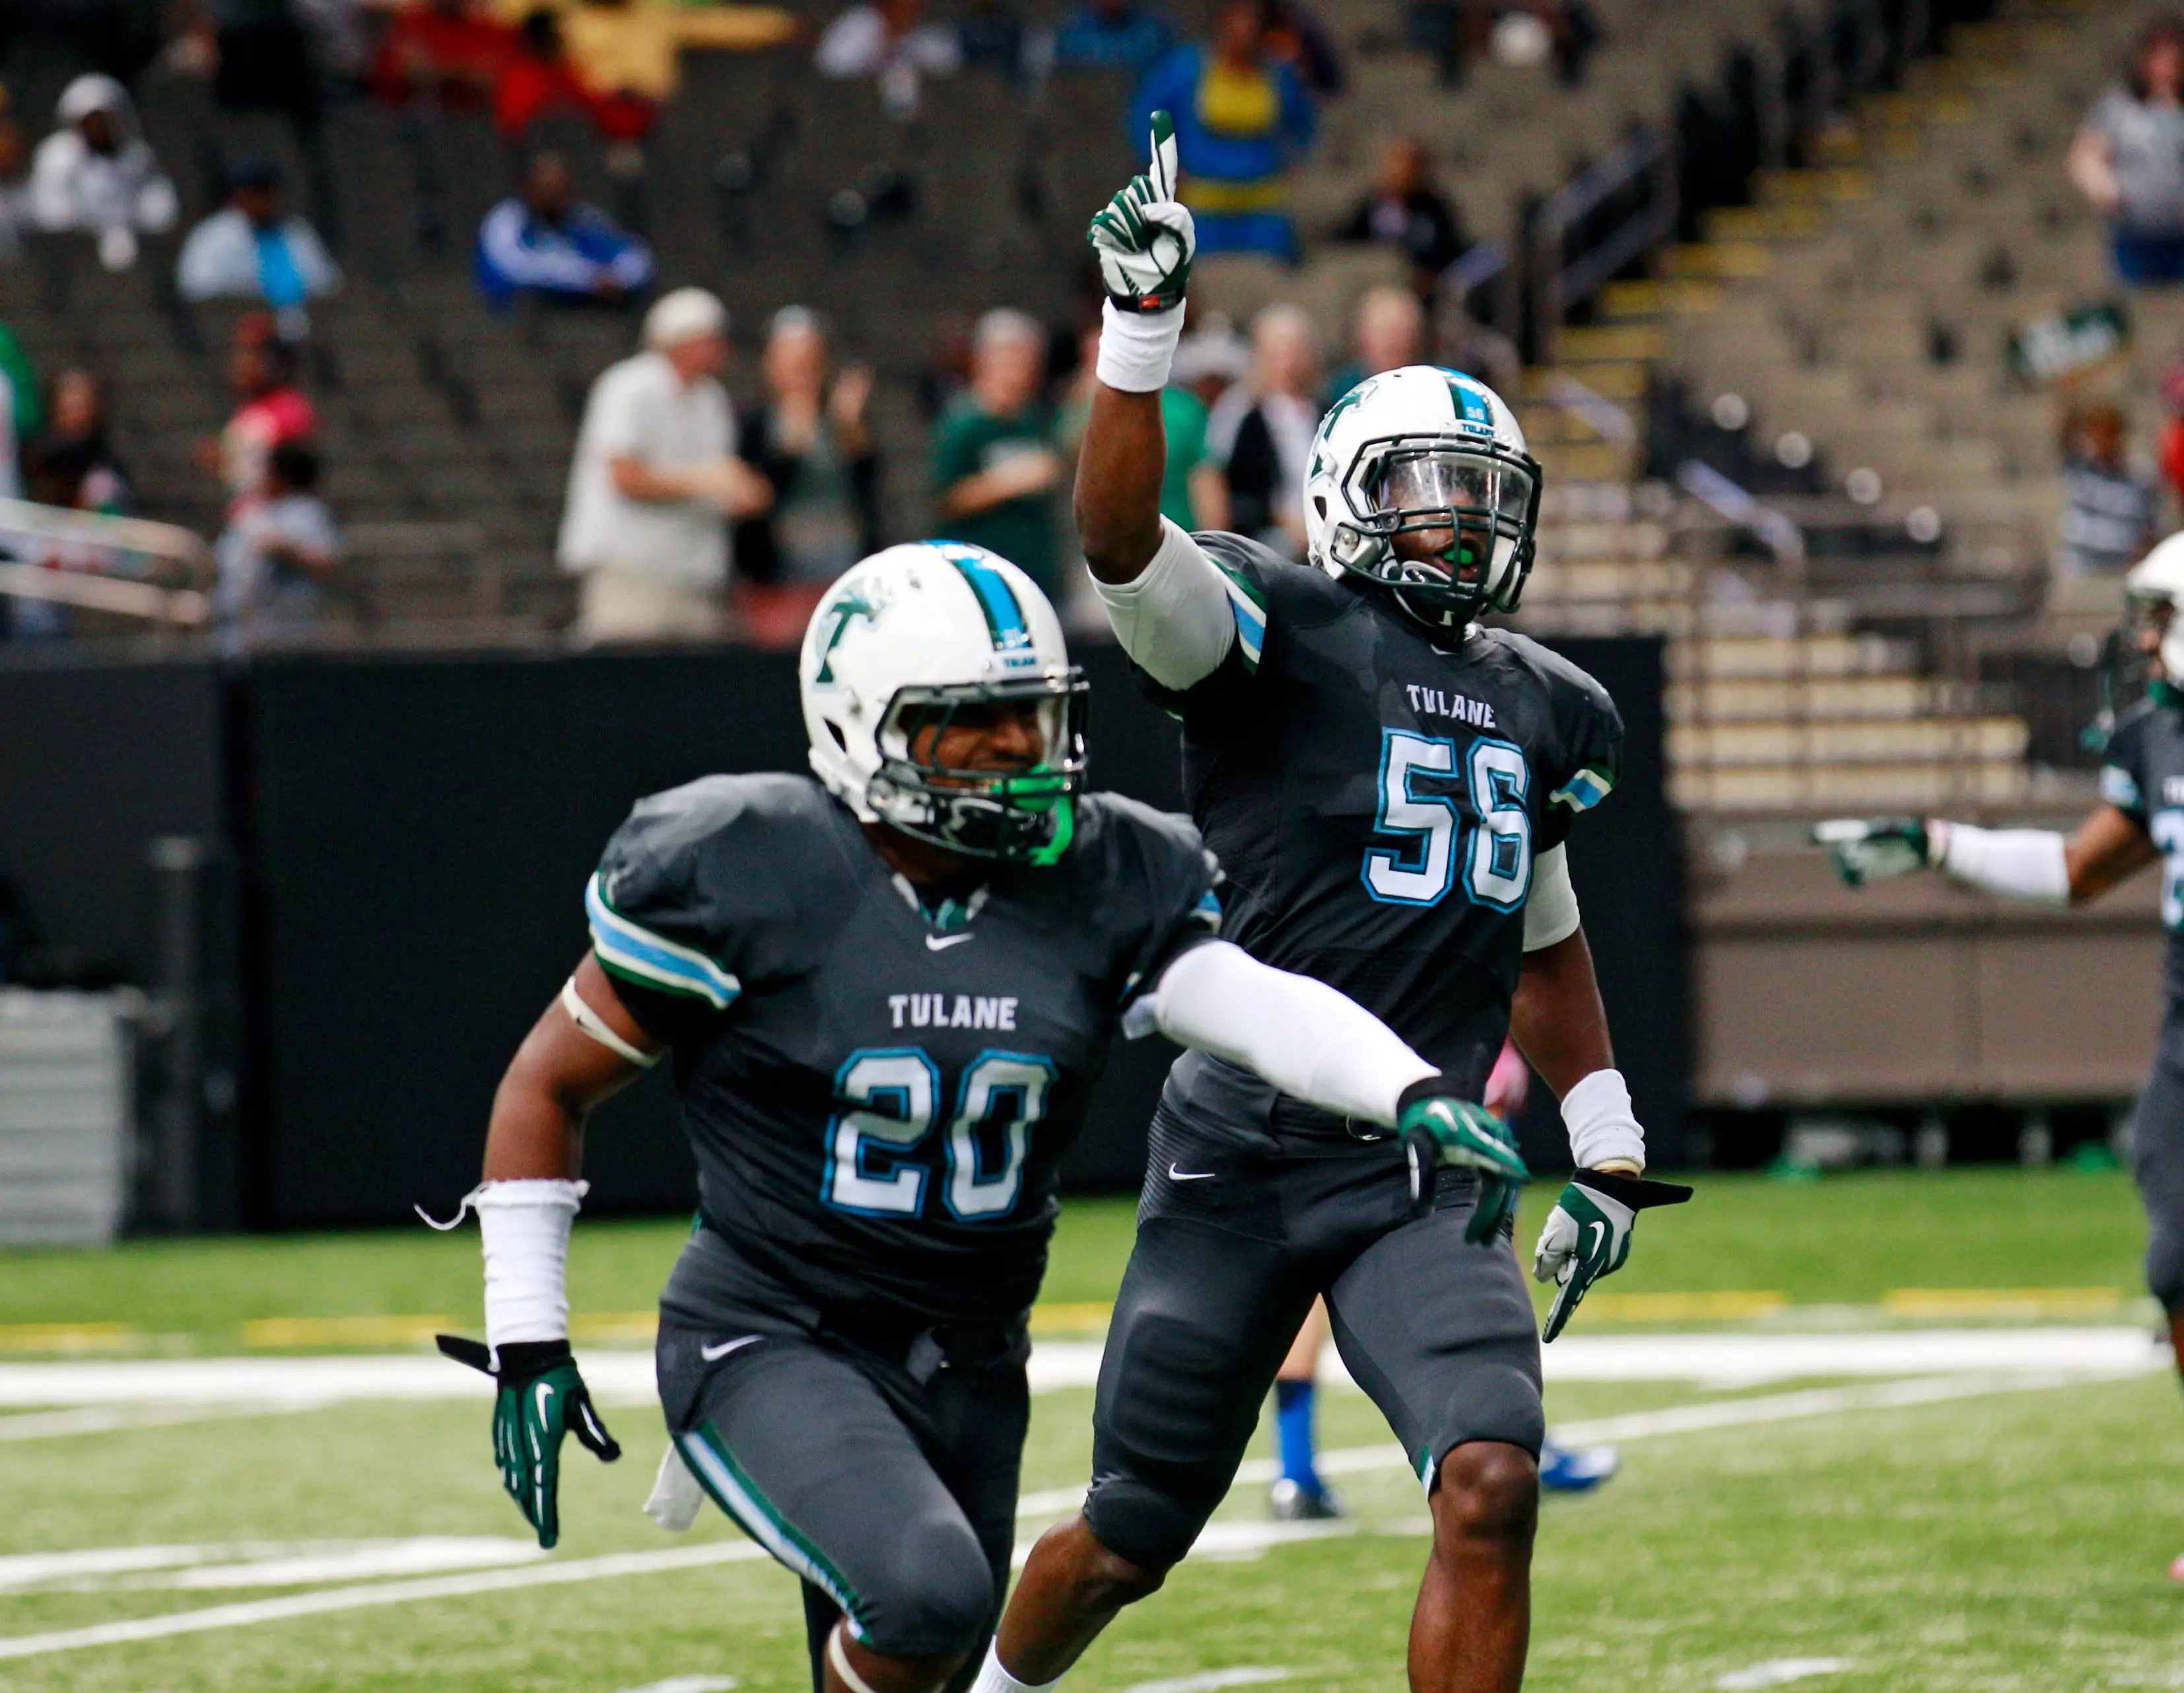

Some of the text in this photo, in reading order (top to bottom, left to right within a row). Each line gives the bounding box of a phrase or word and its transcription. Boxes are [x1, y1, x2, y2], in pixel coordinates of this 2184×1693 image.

[1406, 684, 1496, 728] TULANE
[1360, 726, 1531, 915] 56
[888, 993, 1019, 1031] TULANE
[819, 1046, 1059, 1222] 20
